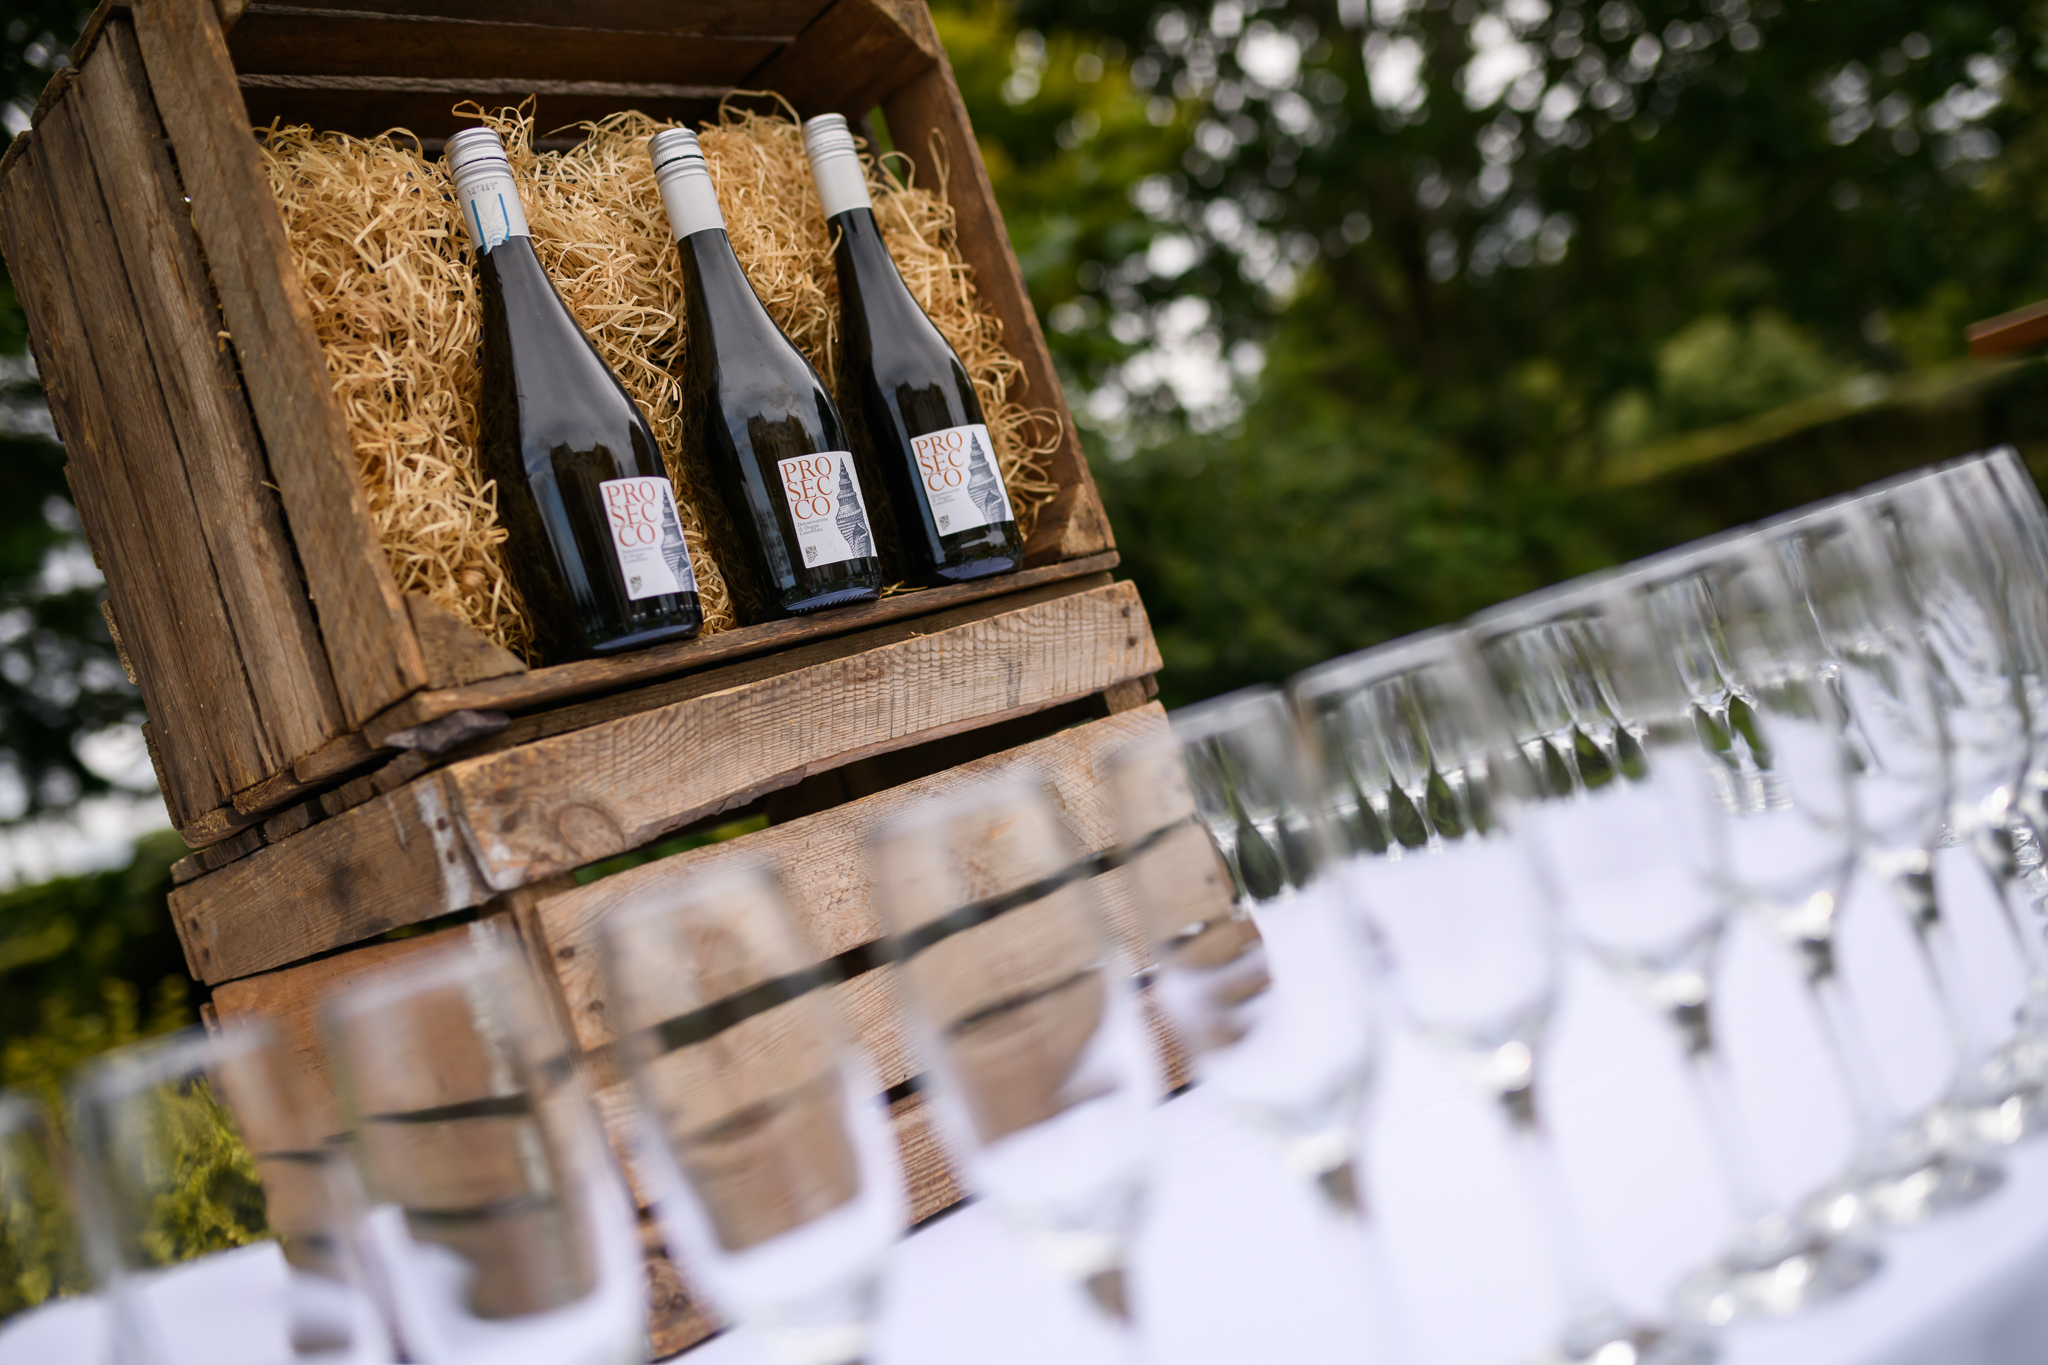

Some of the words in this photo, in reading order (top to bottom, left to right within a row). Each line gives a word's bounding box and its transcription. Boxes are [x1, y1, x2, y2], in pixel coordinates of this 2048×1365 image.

[914, 431, 963, 459] PRO
[781, 456, 832, 483] PRO
[920, 449, 964, 476] SEC
[787, 475, 833, 502] SEC
[927, 468, 962, 491] CO
[605, 481, 655, 507] PRO
[610, 501, 657, 528] SEC
[794, 496, 831, 520] CO
[618, 522, 655, 547] CO
